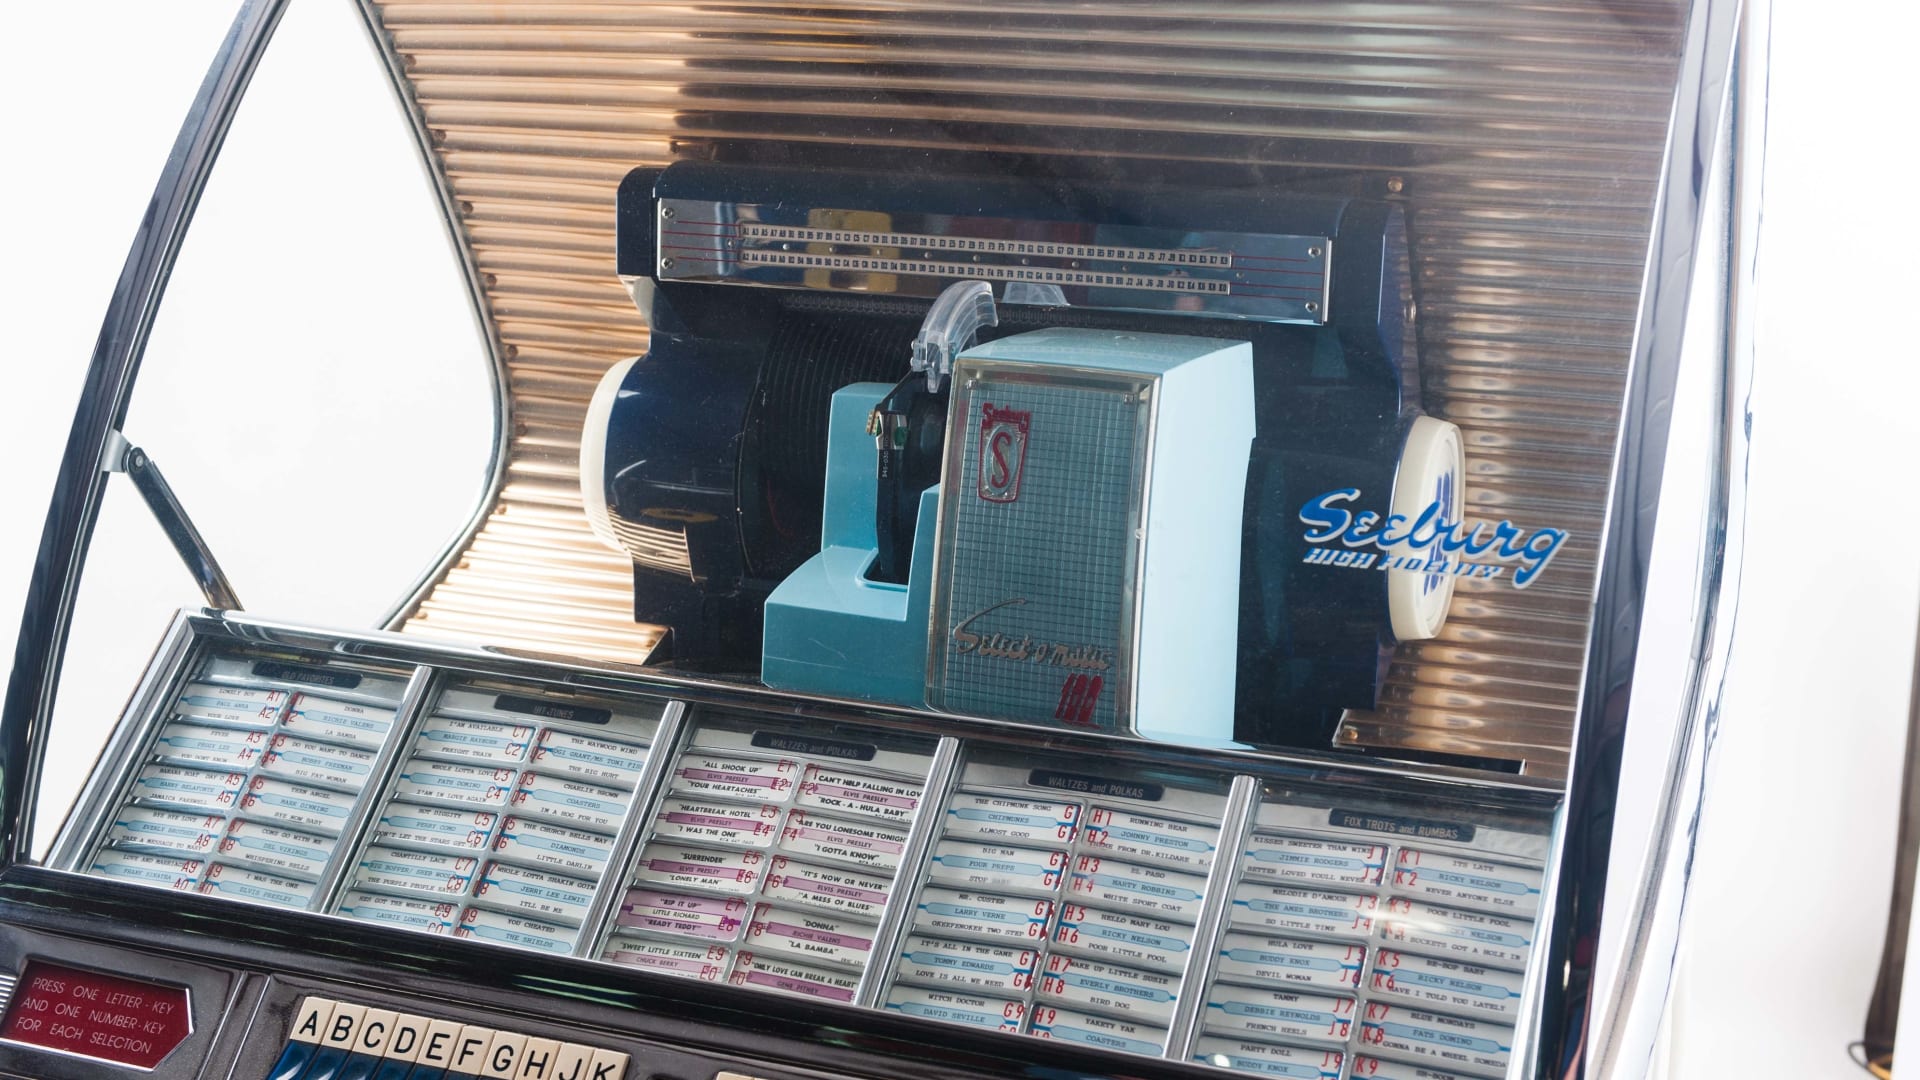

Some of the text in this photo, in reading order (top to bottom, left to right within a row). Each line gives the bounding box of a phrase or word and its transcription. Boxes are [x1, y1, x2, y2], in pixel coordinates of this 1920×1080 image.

[991, 432, 1011, 488] S
[1299, 488, 1570, 590] Seeburg
[1303, 548, 1505, 581] HIGH FIDELITY
[267, 690, 282, 702] A1
[1054, 672, 1103, 722] 100
[259, 708, 275, 719] A2
[247, 732, 263, 743] A3
[238, 748, 253, 760] A4
[863, 783, 893, 793] FALLING
[1049, 777, 1144, 798] WALTZES and POLKAS
[863, 794, 888, 802] PRESLEY
[860, 805, 880, 813] HULA
[833, 825, 874, 837] LONESOME
[979, 827, 1007, 836] ALMOST
[1344, 816, 1458, 839] FOX TROTS and RUMBAS
[847, 839, 872, 848] PRESLEY
[822, 847, 847, 855] GOTTA
[536, 855, 562, 864] LITTLE
[821, 874, 840, 882] NOW
[521, 886, 543, 895] JERRY
[563, 894, 586, 904] LEWIS
[837, 888, 862, 897] PRESLEY
[812, 895, 830, 903] MESS
[673, 912, 700, 920] RICHARD
[524, 922, 555, 933] CHEATED
[772, 966, 787, 975] LOVE
[791, 969, 802, 977] CAN
[805, 971, 824, 982] BREAK
[32, 977, 66, 993] PRESS
[73, 985, 99, 1000] ONE
[1080, 979, 1154, 998] EVERLY BROTHERS
[928, 993, 952, 1003] WITCH
[1090, 997, 1110, 1005] BIRD
[21, 997, 48, 1011] AND
[55, 1003, 82, 1018] ONE
[924, 1008, 985, 1023] DAVID SEVILLE
[16, 1017, 151, 1054] FOR EACH SELECTION
[1086, 1034, 1126, 1047] COASTERS
[299, 1010, 616, 1080] A B C D E F G H J K
